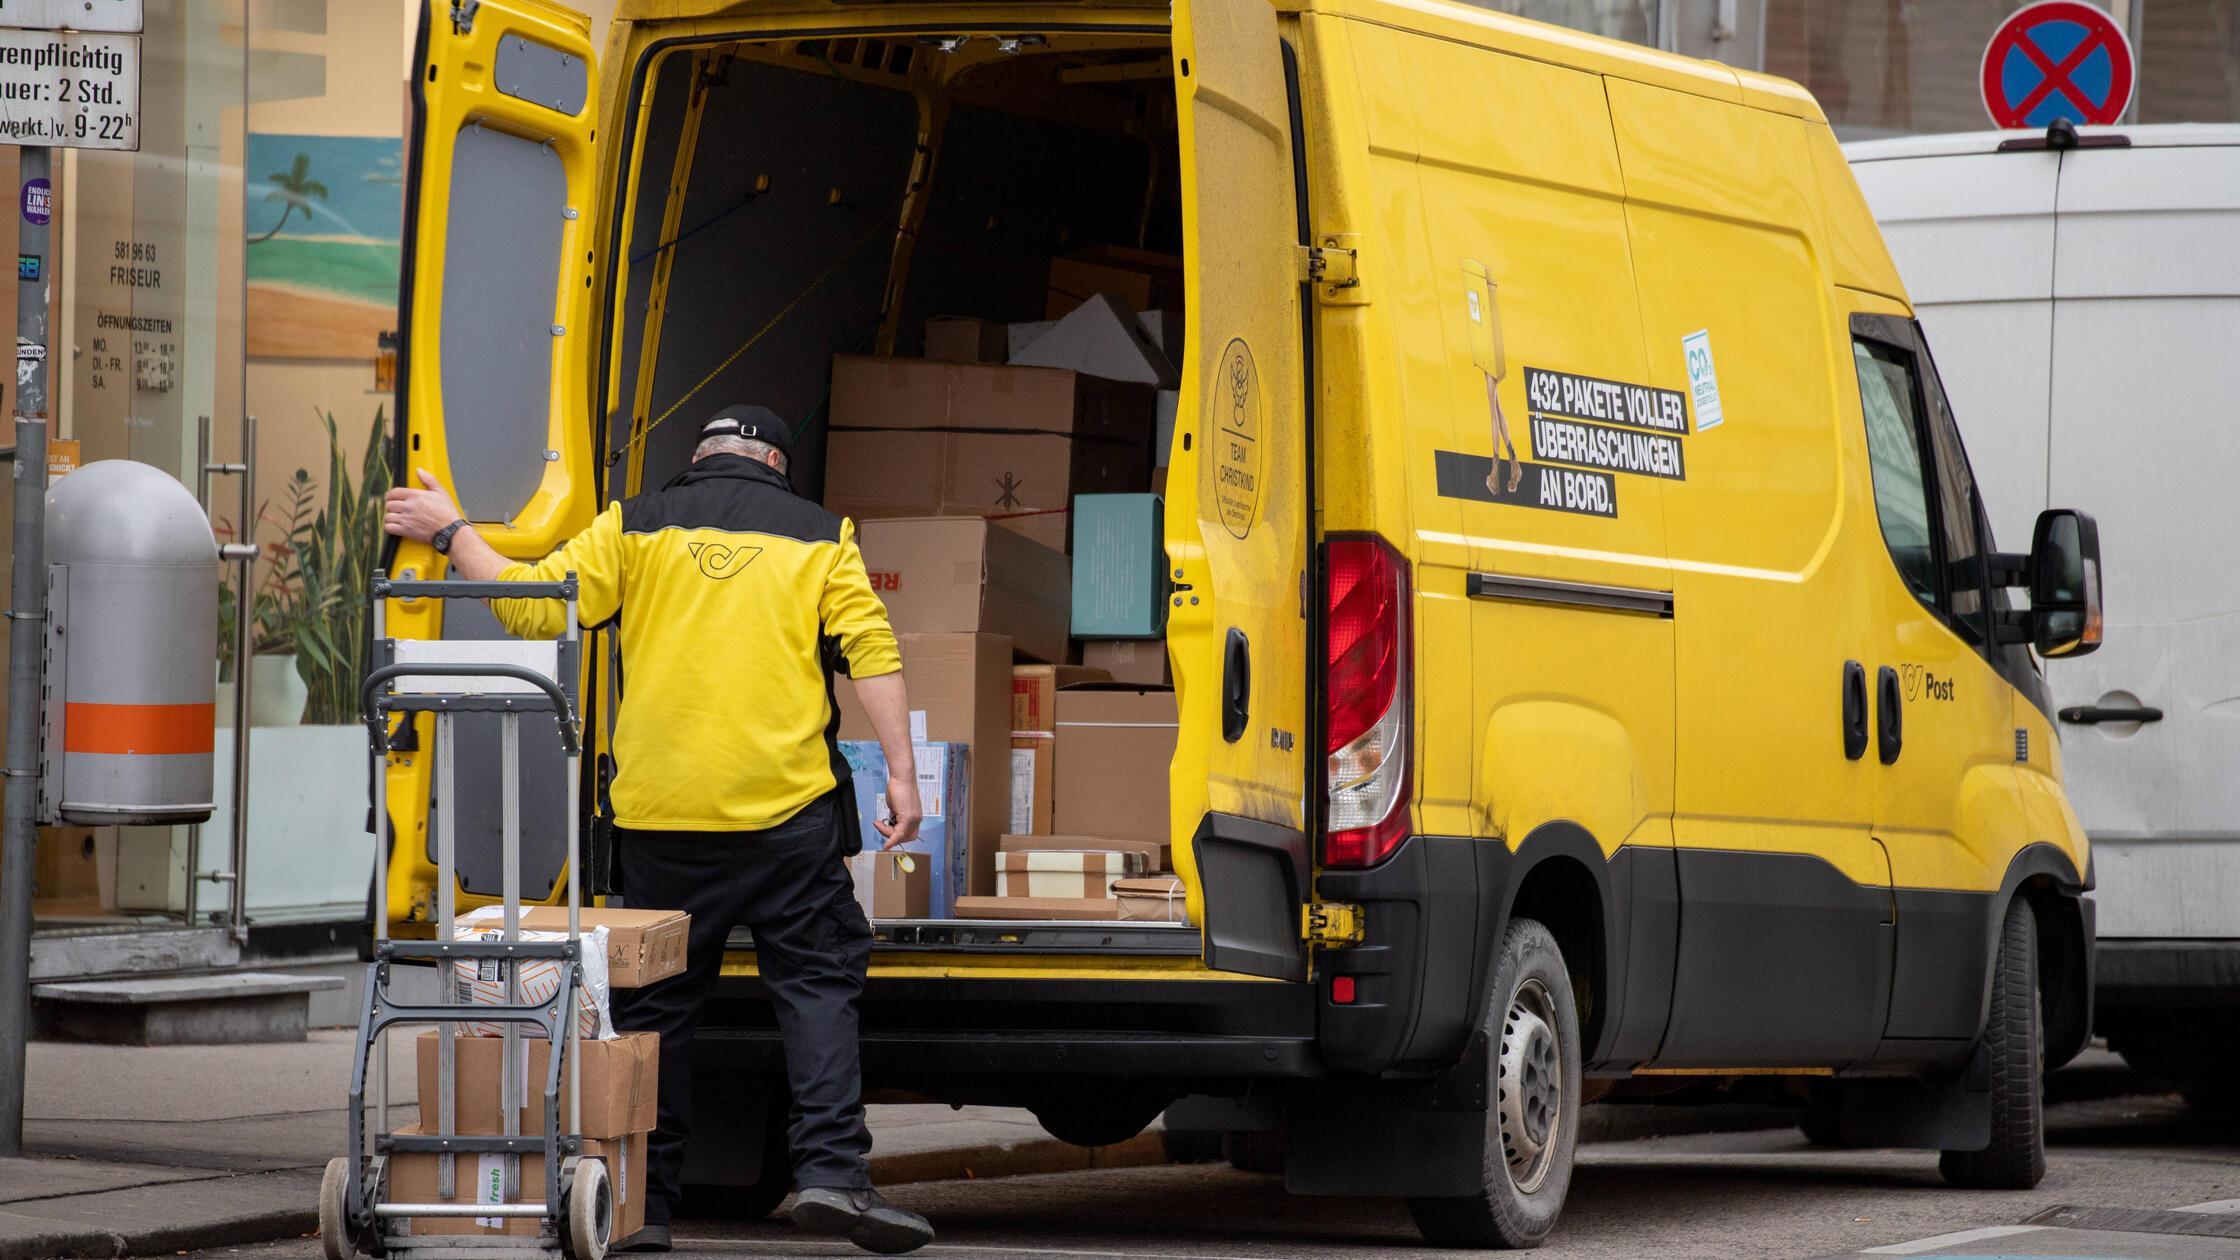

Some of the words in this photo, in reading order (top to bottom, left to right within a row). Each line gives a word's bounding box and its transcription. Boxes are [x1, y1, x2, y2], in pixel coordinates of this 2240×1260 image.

[0, 82, 50, 101] uer:
[58, 78, 71, 103] 2
[78, 79, 122, 105] Std.
[110, 266, 161, 288] FRISEUR
[97, 311, 172, 333] ÖFFNUNGSZEITEN
[1530, 372, 1562, 411] 432
[1563, 376, 1625, 421] PAKETE
[1624, 387, 1684, 431] VOLLER
[1231, 443, 1246, 464] TEAM
[1534, 412, 1681, 476] ÜBERRASCHUNGEN
[1220, 465, 1254, 492] CHRISTKIND
[1540, 468, 1562, 507] AN
[1564, 474, 1614, 513] BORD.
[1926, 673, 1954, 701] Post
[490, 1168, 500, 1202] fresh
